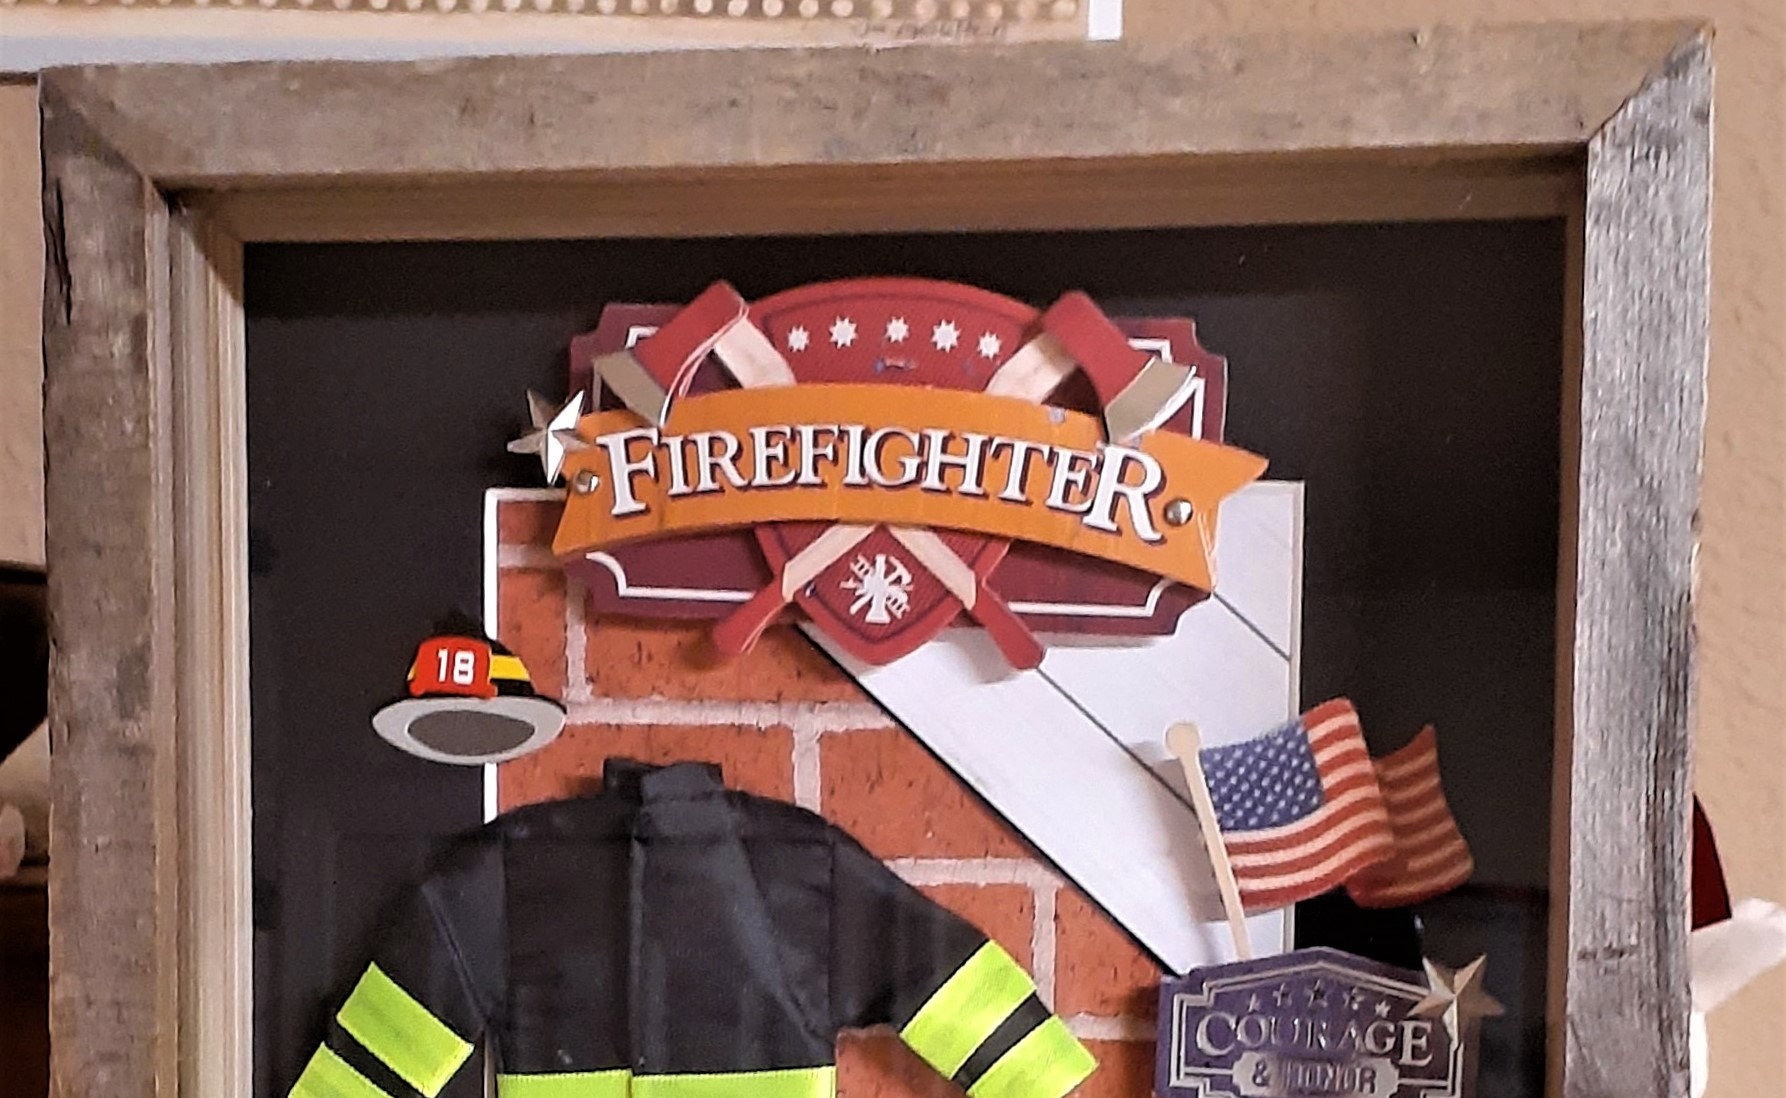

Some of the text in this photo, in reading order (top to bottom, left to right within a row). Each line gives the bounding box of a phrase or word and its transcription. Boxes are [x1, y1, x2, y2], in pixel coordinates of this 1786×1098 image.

[595, 421, 1165, 543] FIREFIGHTER
[437, 648, 475, 686] 18
[1195, 1011, 1434, 1068] COURAGE
[1251, 1061, 1271, 1088] &
